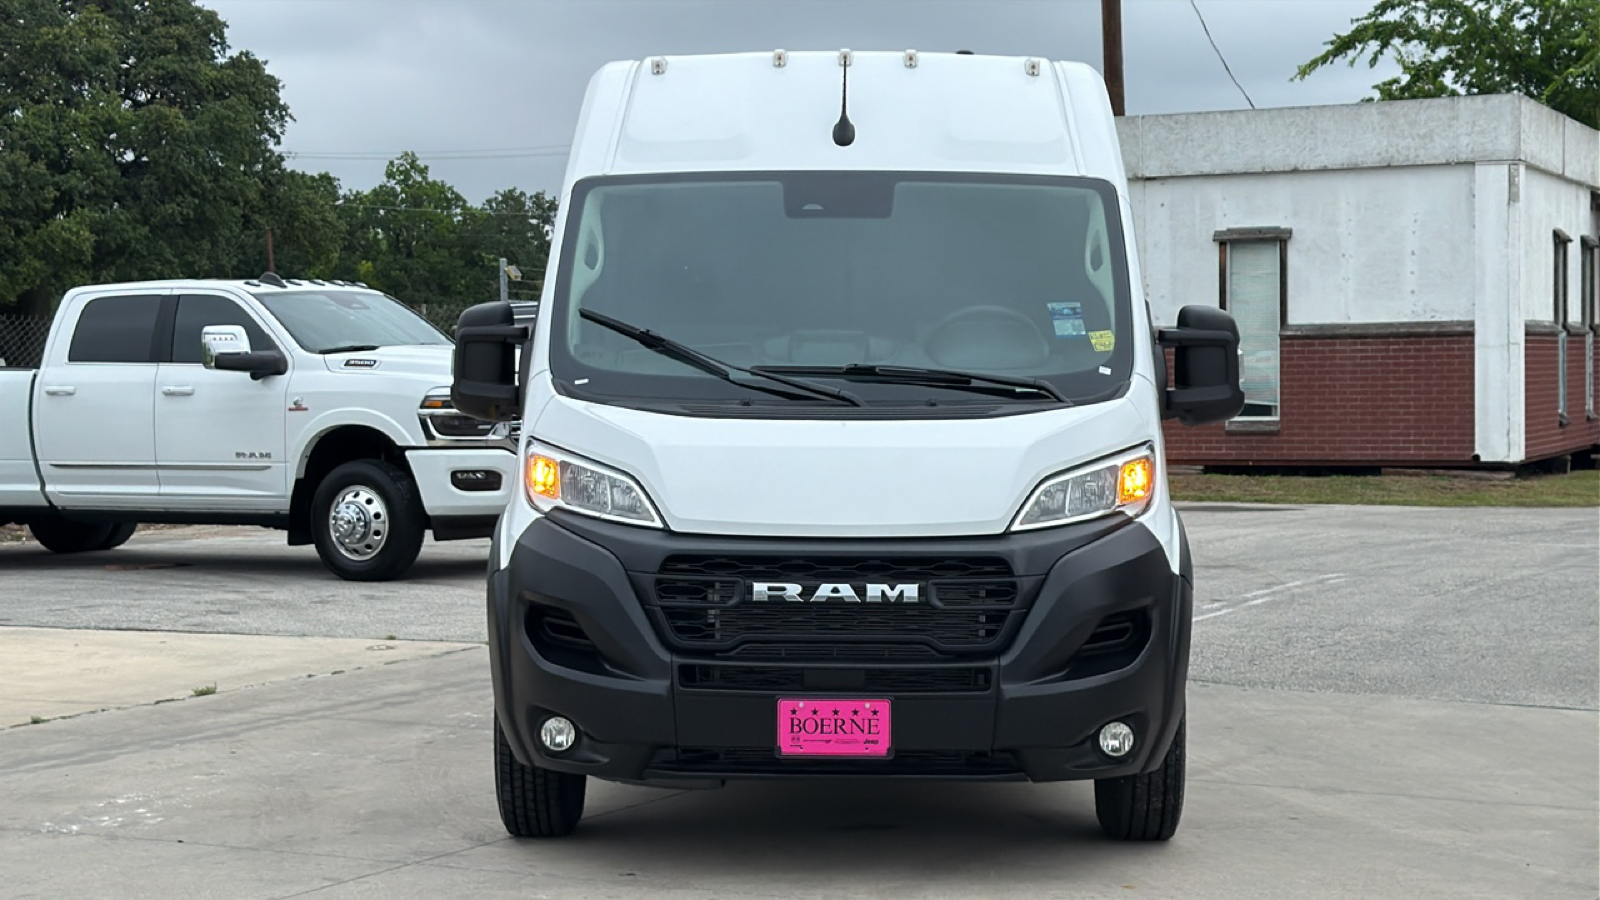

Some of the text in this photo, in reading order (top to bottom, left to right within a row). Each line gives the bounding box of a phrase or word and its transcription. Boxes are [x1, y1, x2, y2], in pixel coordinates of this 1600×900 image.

[235, 451, 271, 460] RAM
[753, 582, 919, 603] RAM
[790, 717, 880, 735] BOERNE
